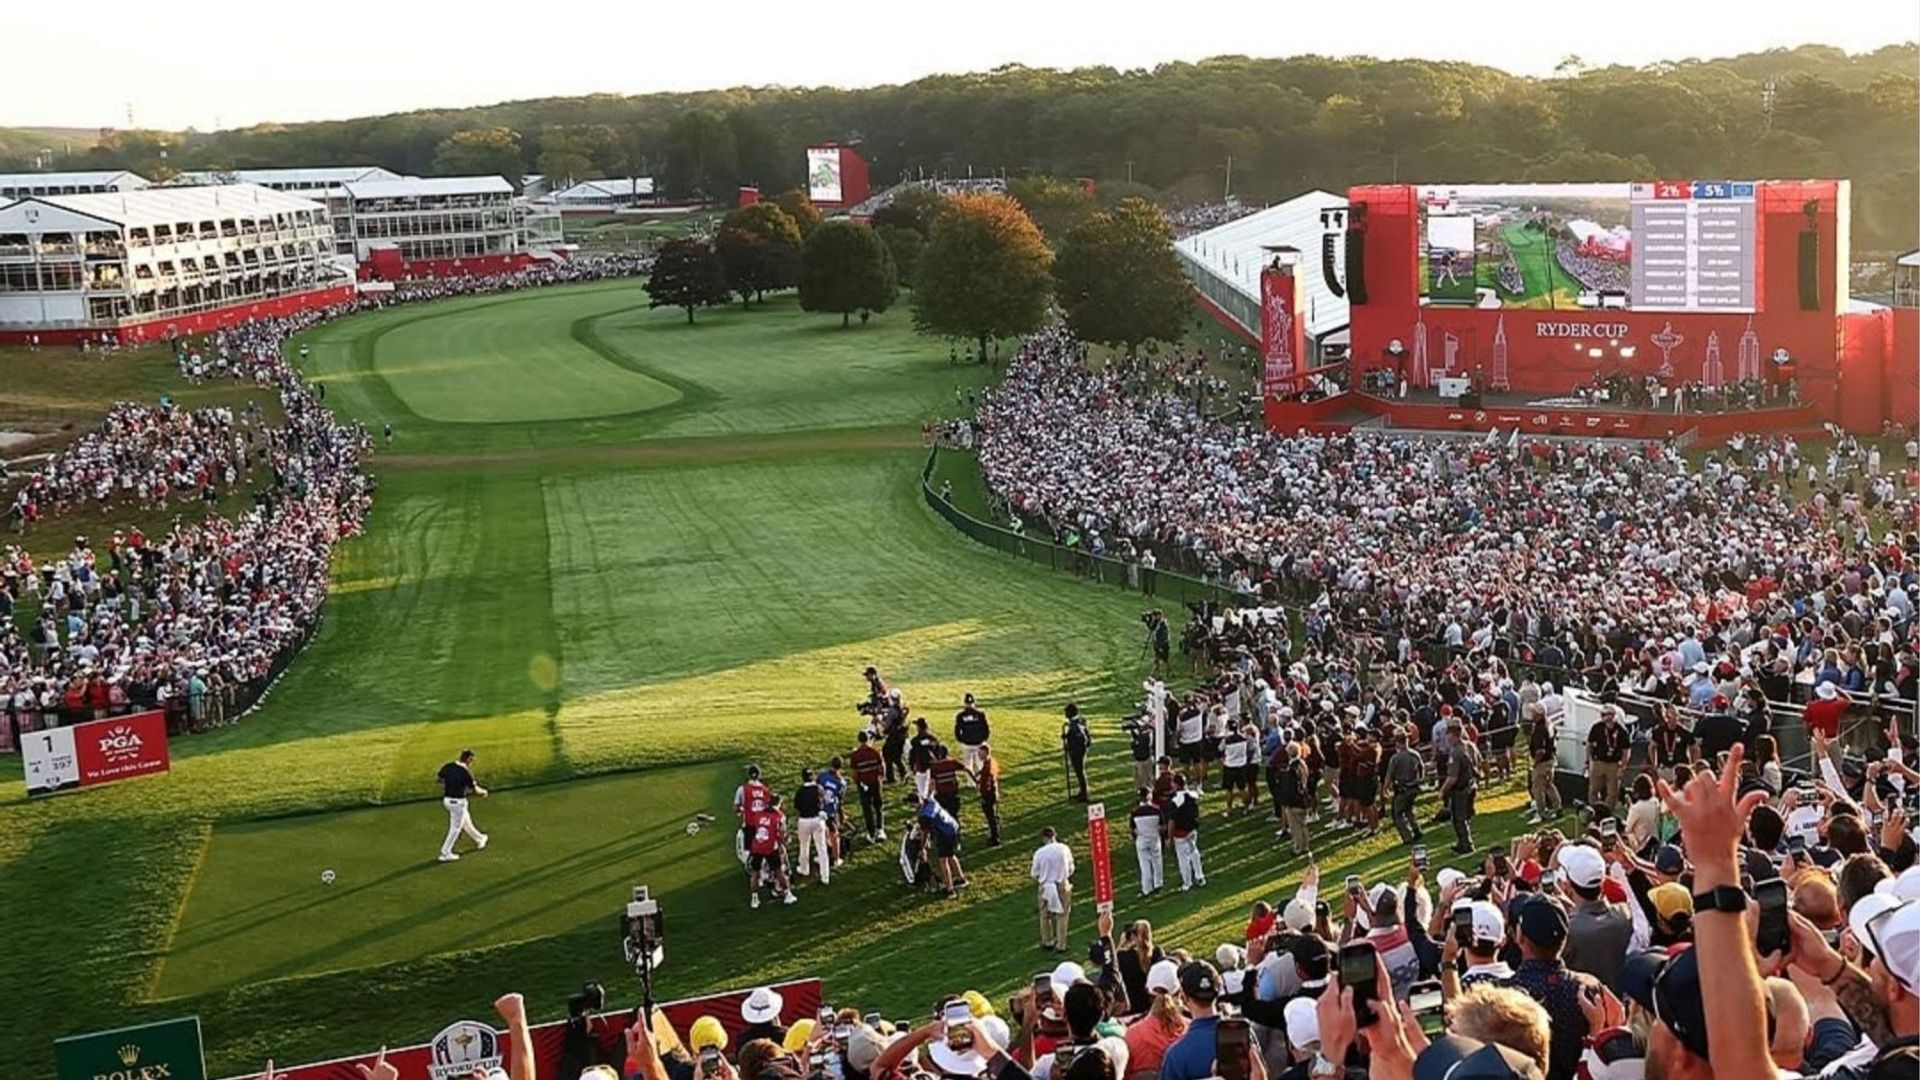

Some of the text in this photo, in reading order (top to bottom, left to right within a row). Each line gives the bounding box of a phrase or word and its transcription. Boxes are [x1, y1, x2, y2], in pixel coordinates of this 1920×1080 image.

[1537, 322, 1628, 338] RYDER CUP
[42, 736, 53, 753] 1
[99, 734, 143, 752] PGA
